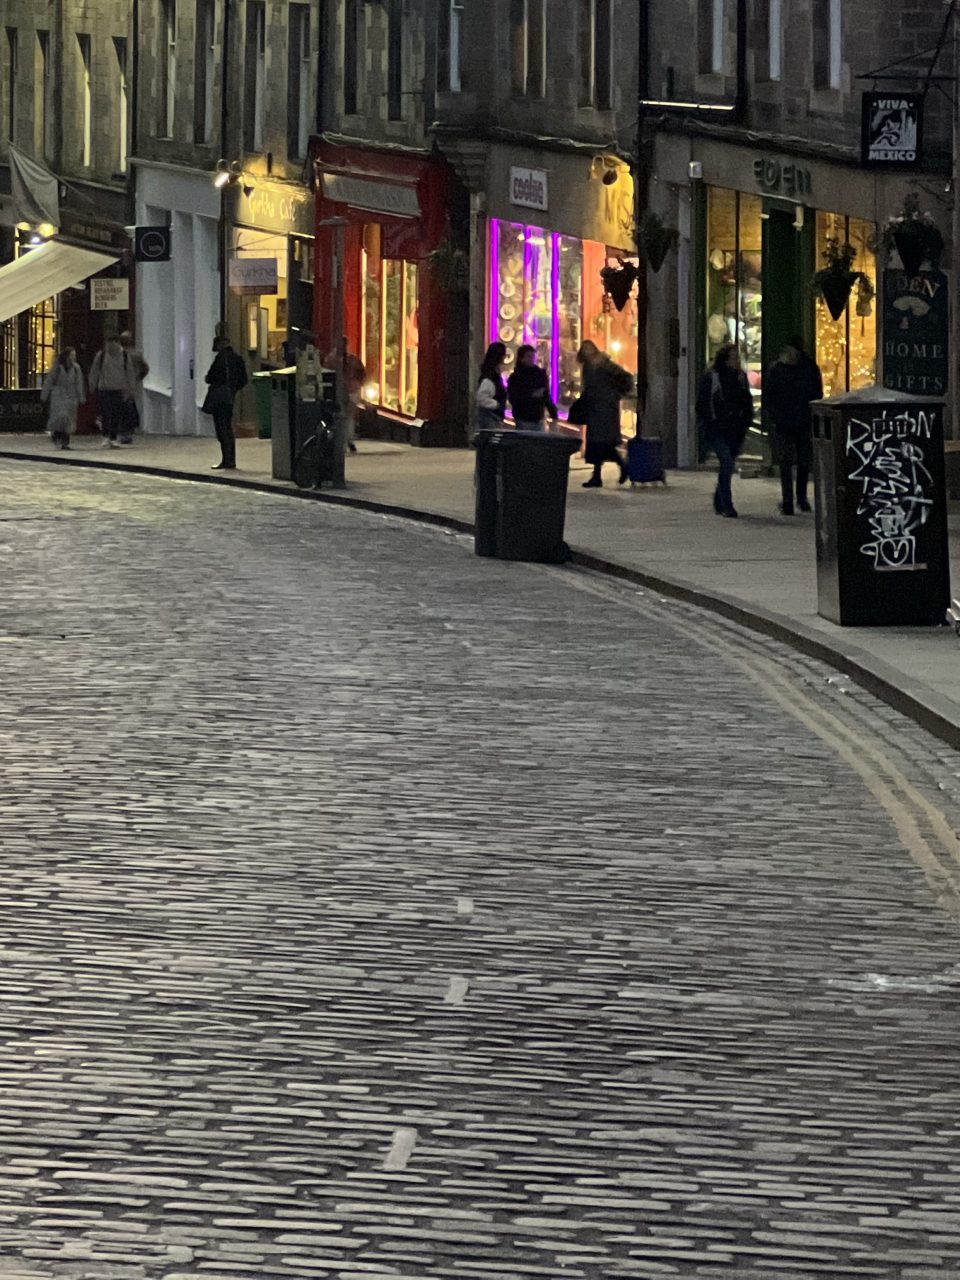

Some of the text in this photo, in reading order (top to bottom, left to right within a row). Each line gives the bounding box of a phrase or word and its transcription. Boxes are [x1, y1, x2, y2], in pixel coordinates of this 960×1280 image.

[877, 99, 910, 109] VIVA
[868, 150, 916, 161] MEXICO
[885, 342, 944, 359] HOME
[886, 374, 943, 390] GIFTS
